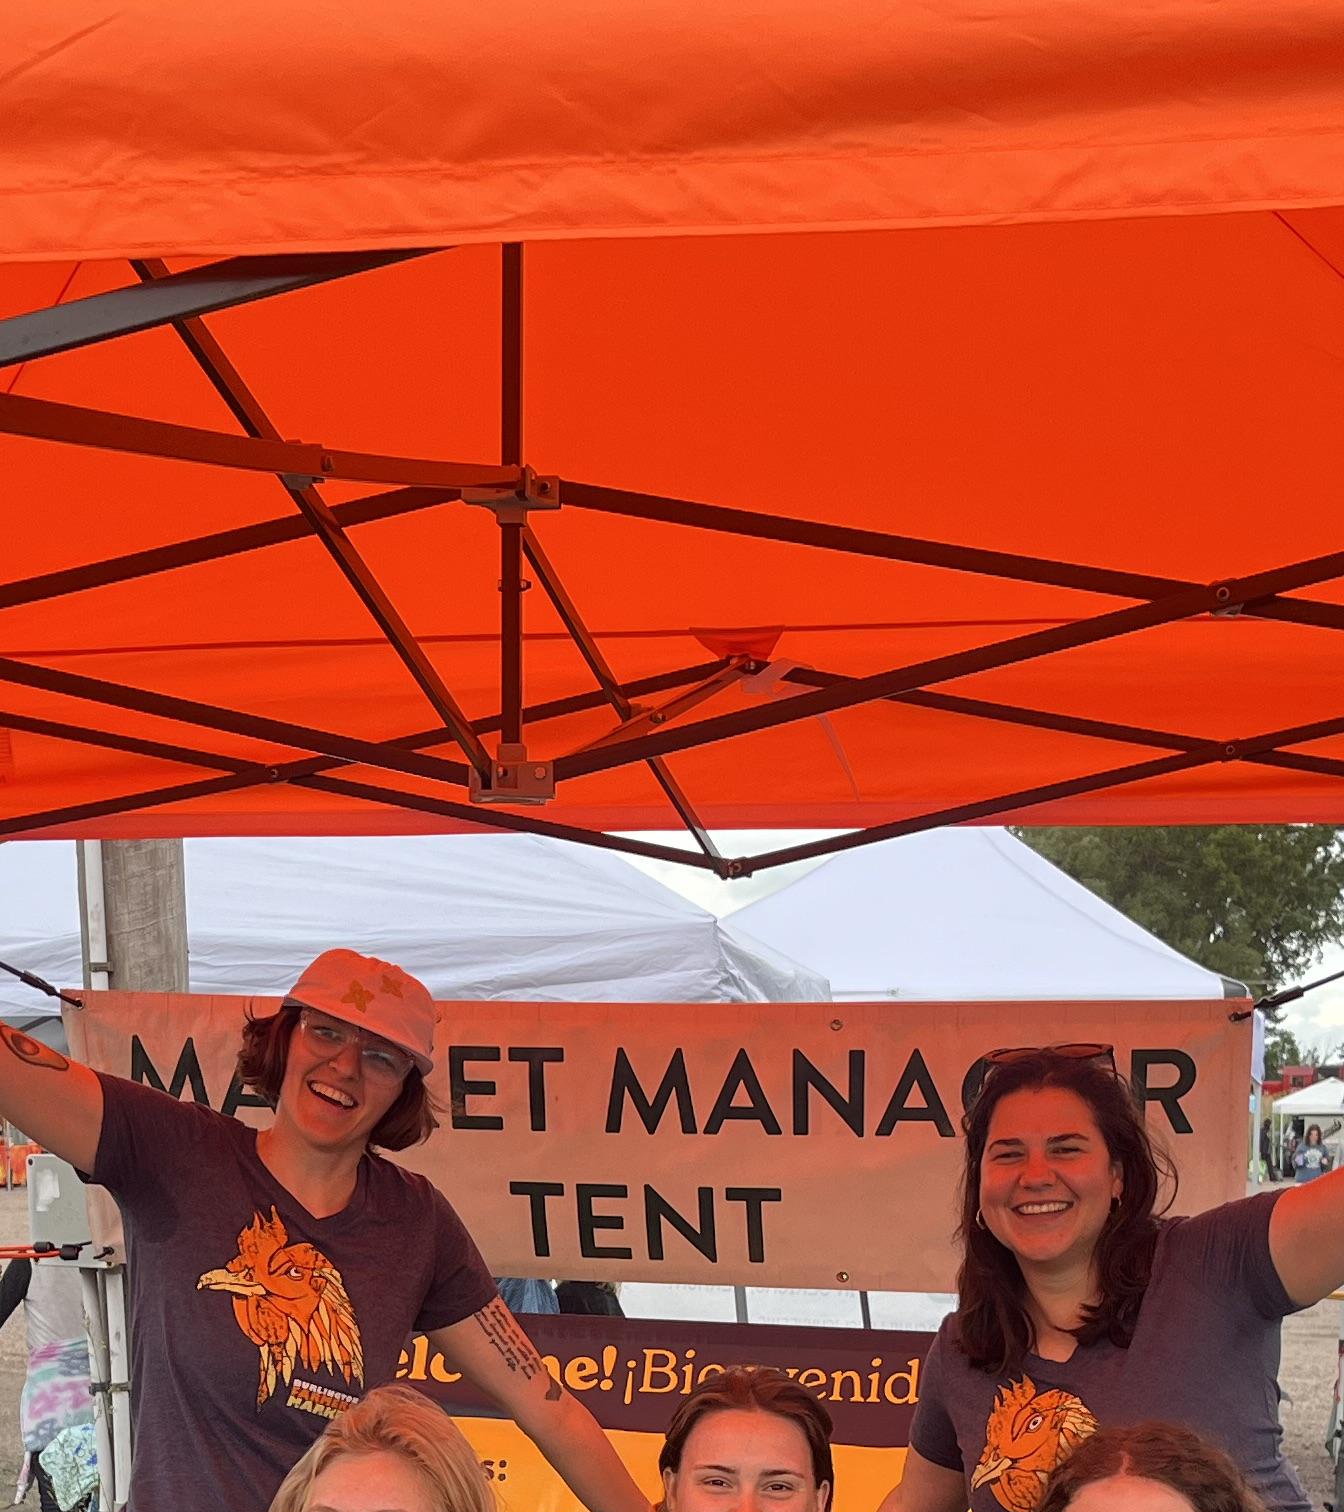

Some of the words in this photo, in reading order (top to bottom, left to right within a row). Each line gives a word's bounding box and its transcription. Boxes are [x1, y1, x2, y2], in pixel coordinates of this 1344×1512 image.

[605, 1047, 1197, 1138] MANAR
[509, 1181, 782, 1264] TENT
[291, 1386, 351, 1412] FARMER
[293, 1378, 360, 1405] BURLINGTON
[286, 1395, 345, 1420] MARK
